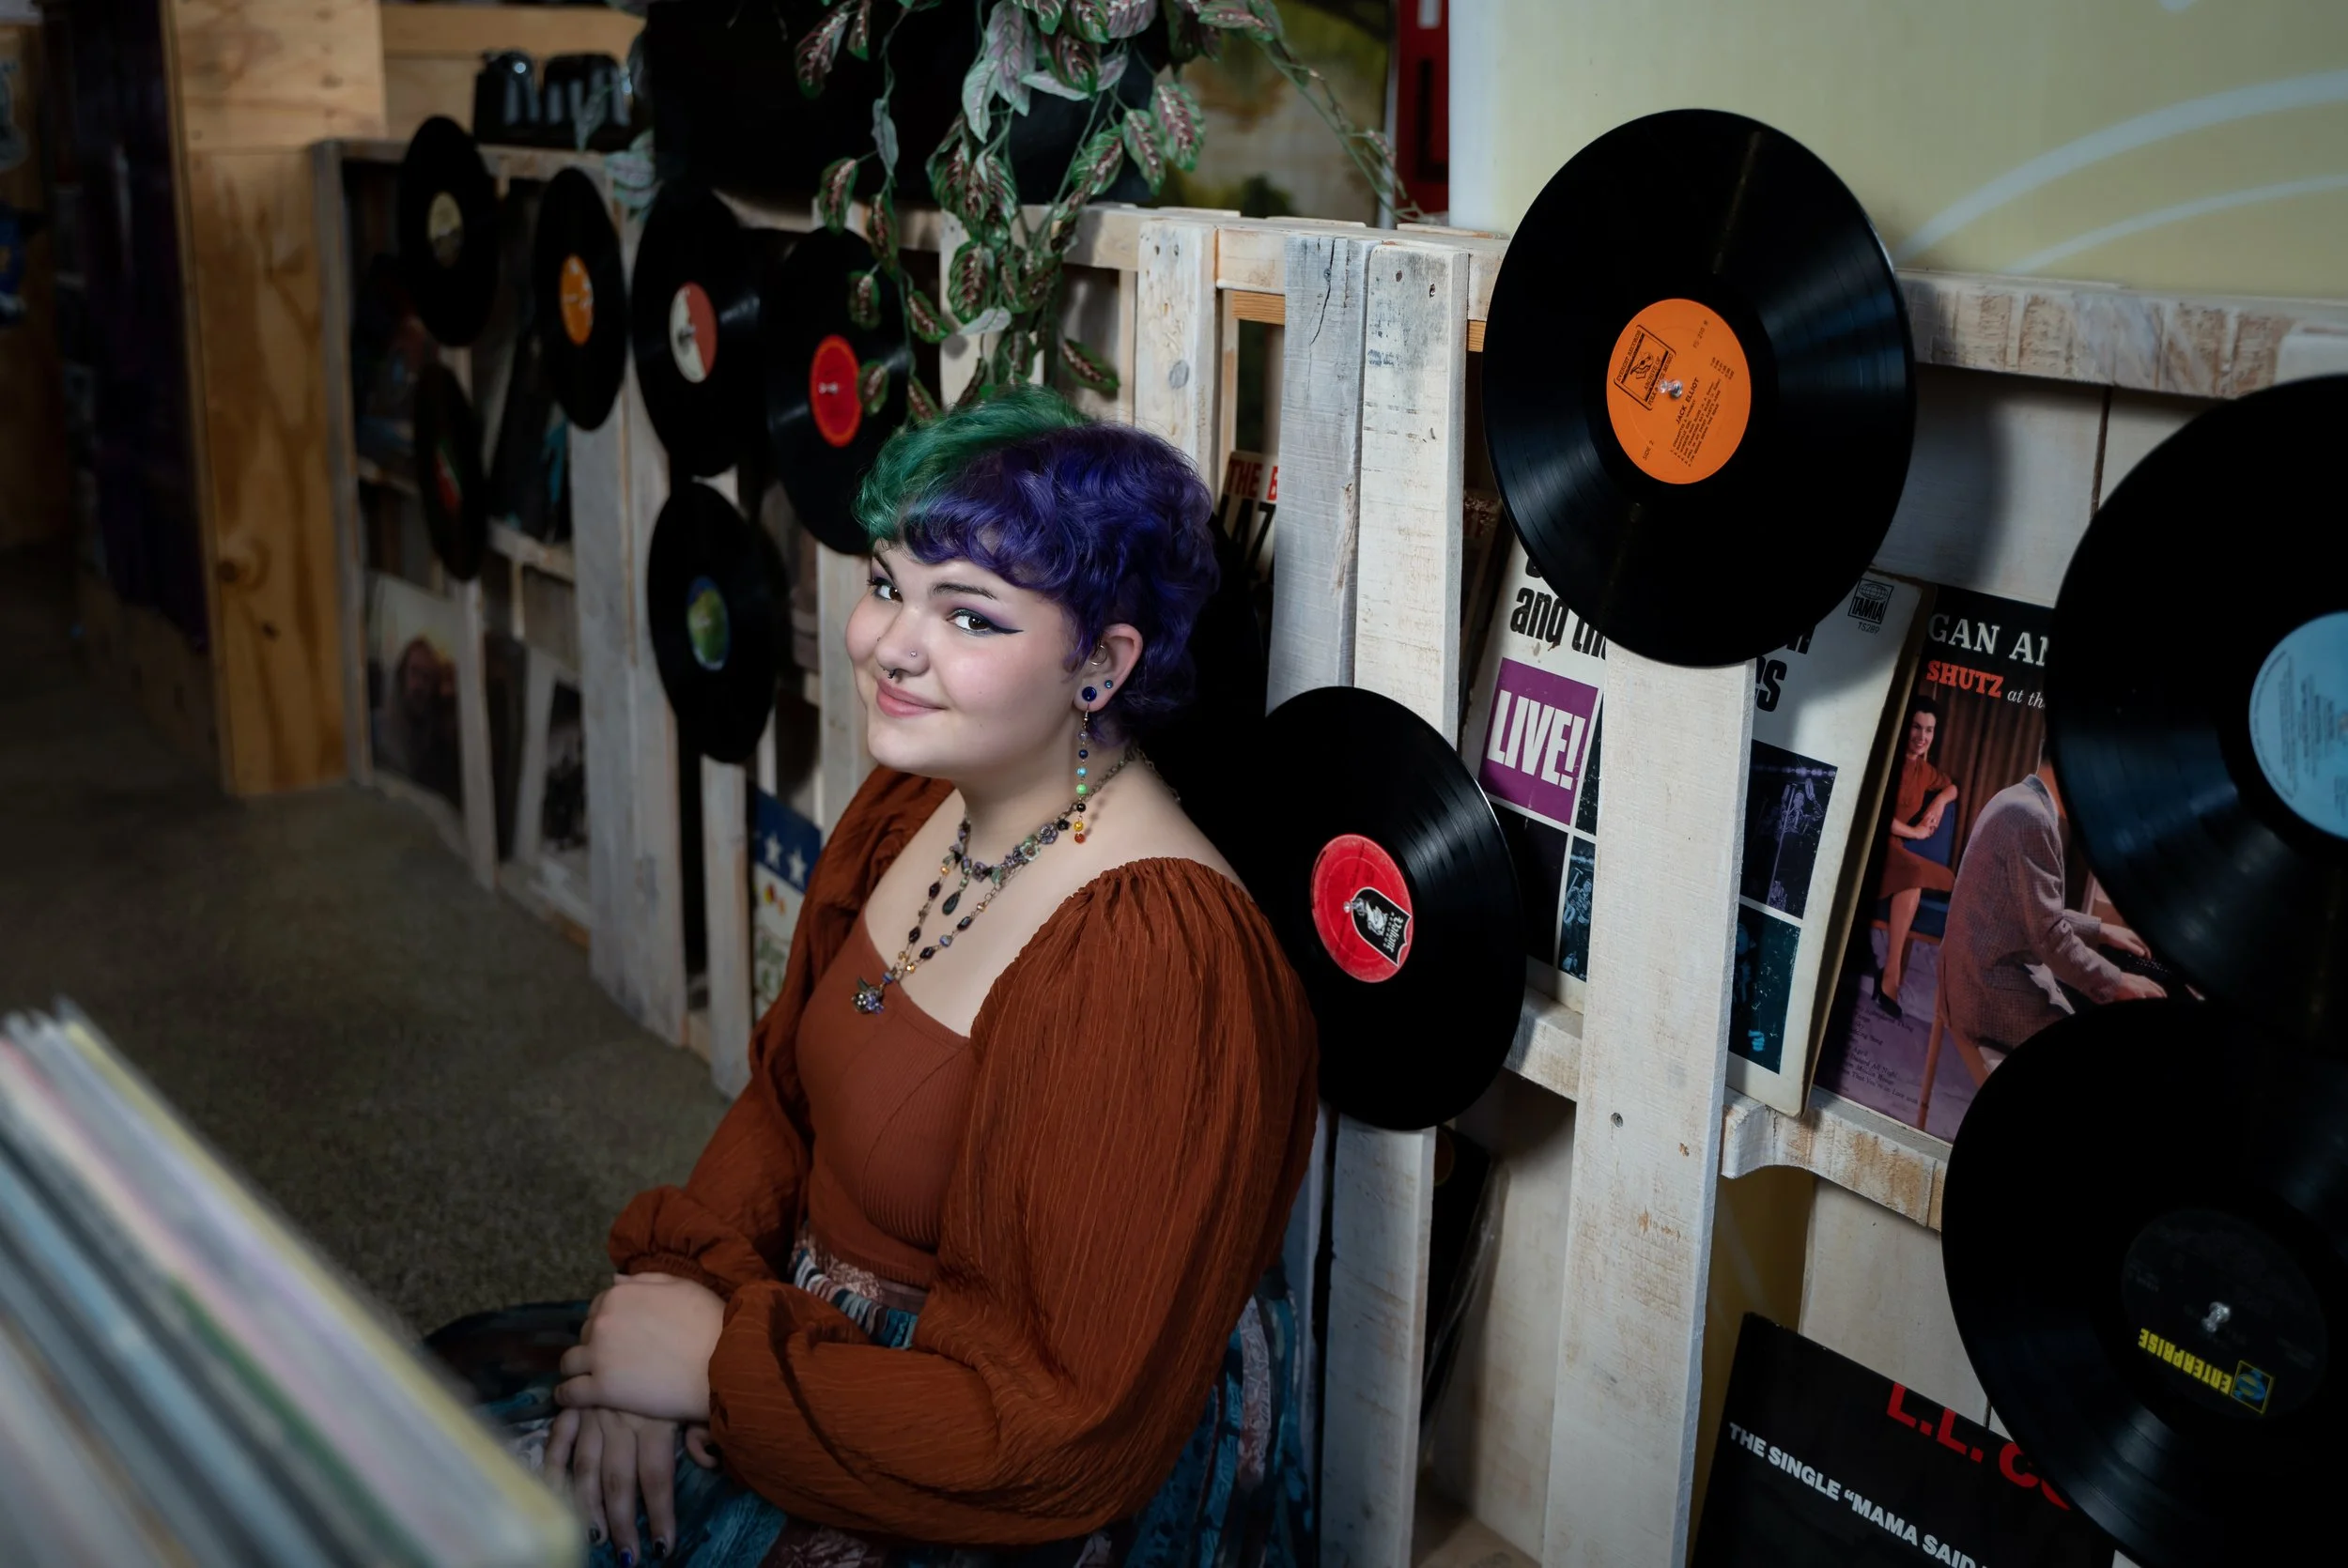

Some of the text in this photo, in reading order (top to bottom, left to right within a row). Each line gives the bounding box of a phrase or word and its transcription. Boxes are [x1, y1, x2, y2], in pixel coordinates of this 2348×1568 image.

[1615, 330, 1641, 381] EVEREST RECORDS
[1643, 364, 1657, 390] ARCHIVE
[1676, 377, 1699, 423] JACK ELLIOT
[1642, 445, 1651, 460] SIDE
[1227, 458, 1262, 498] THE
[1510, 587, 1569, 646] and
[1927, 612, 2001, 655] GAN
[1924, 659, 2047, 709] SHUTZ at th
[1487, 689, 1586, 791] LIVE!
[2138, 1328, 2233, 1395] ENTERPRISE
[1886, 1382, 1984, 1465] L.L.
[1729, 1422, 1767, 1458] THE
[1768, 1445, 1842, 1501] SINGLE
